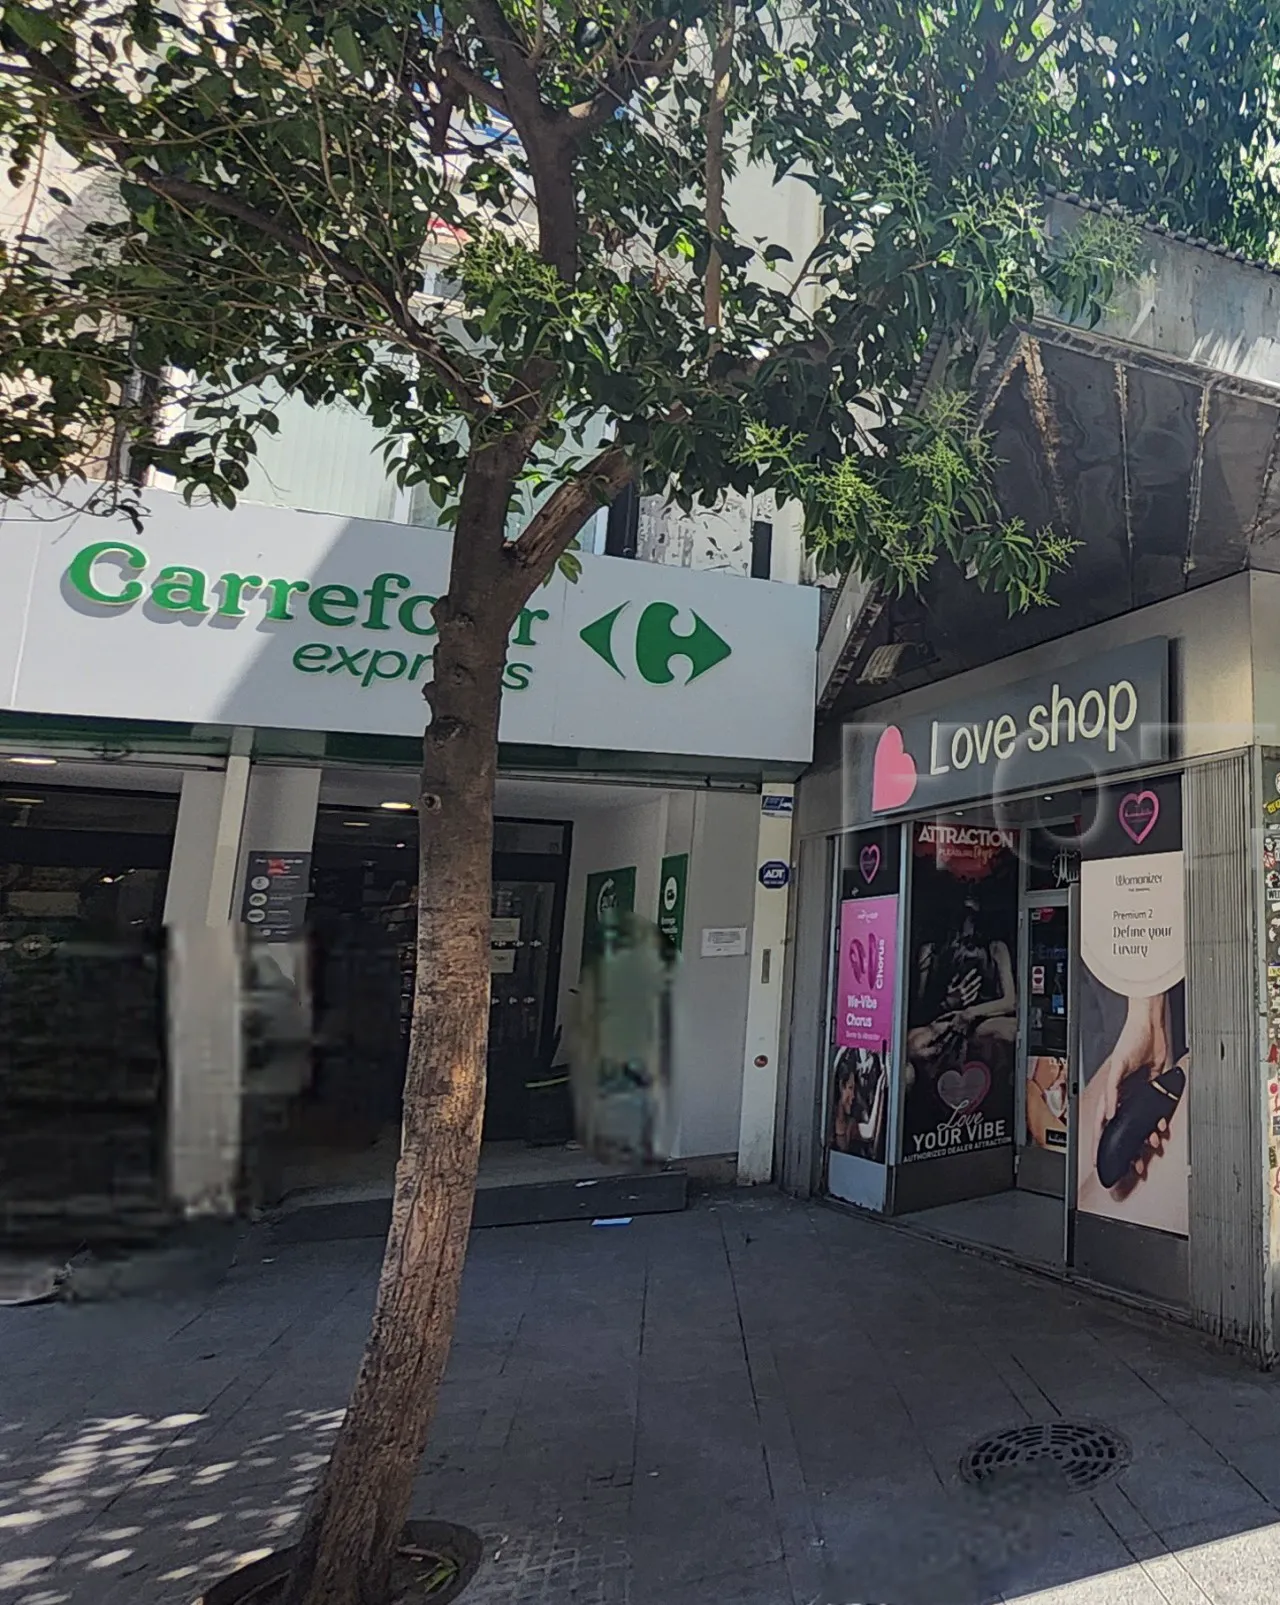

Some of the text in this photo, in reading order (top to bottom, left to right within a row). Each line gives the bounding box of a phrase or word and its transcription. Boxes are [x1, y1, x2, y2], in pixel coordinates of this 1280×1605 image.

[67, 541, 550, 646] Carrefor
[292, 638, 534, 691] exprs
[929, 680, 1138, 776] Love shop
[918, 825, 1013, 848] ATTRACTION
[763, 869, 785, 879] ADT
[1115, 872, 1163, 886] Womanizer
[1113, 908, 1153, 920] Premium 2
[1113, 925, 1172, 940] Define your
[1113, 943, 1148, 958] Luxury
[876, 939, 886, 990] Chorus
[936, 1099, 985, 1132] Love
[912, 1119, 1006, 1152] YOUR VIBE
[903, 1148, 947, 1163] AUTHORIZED
